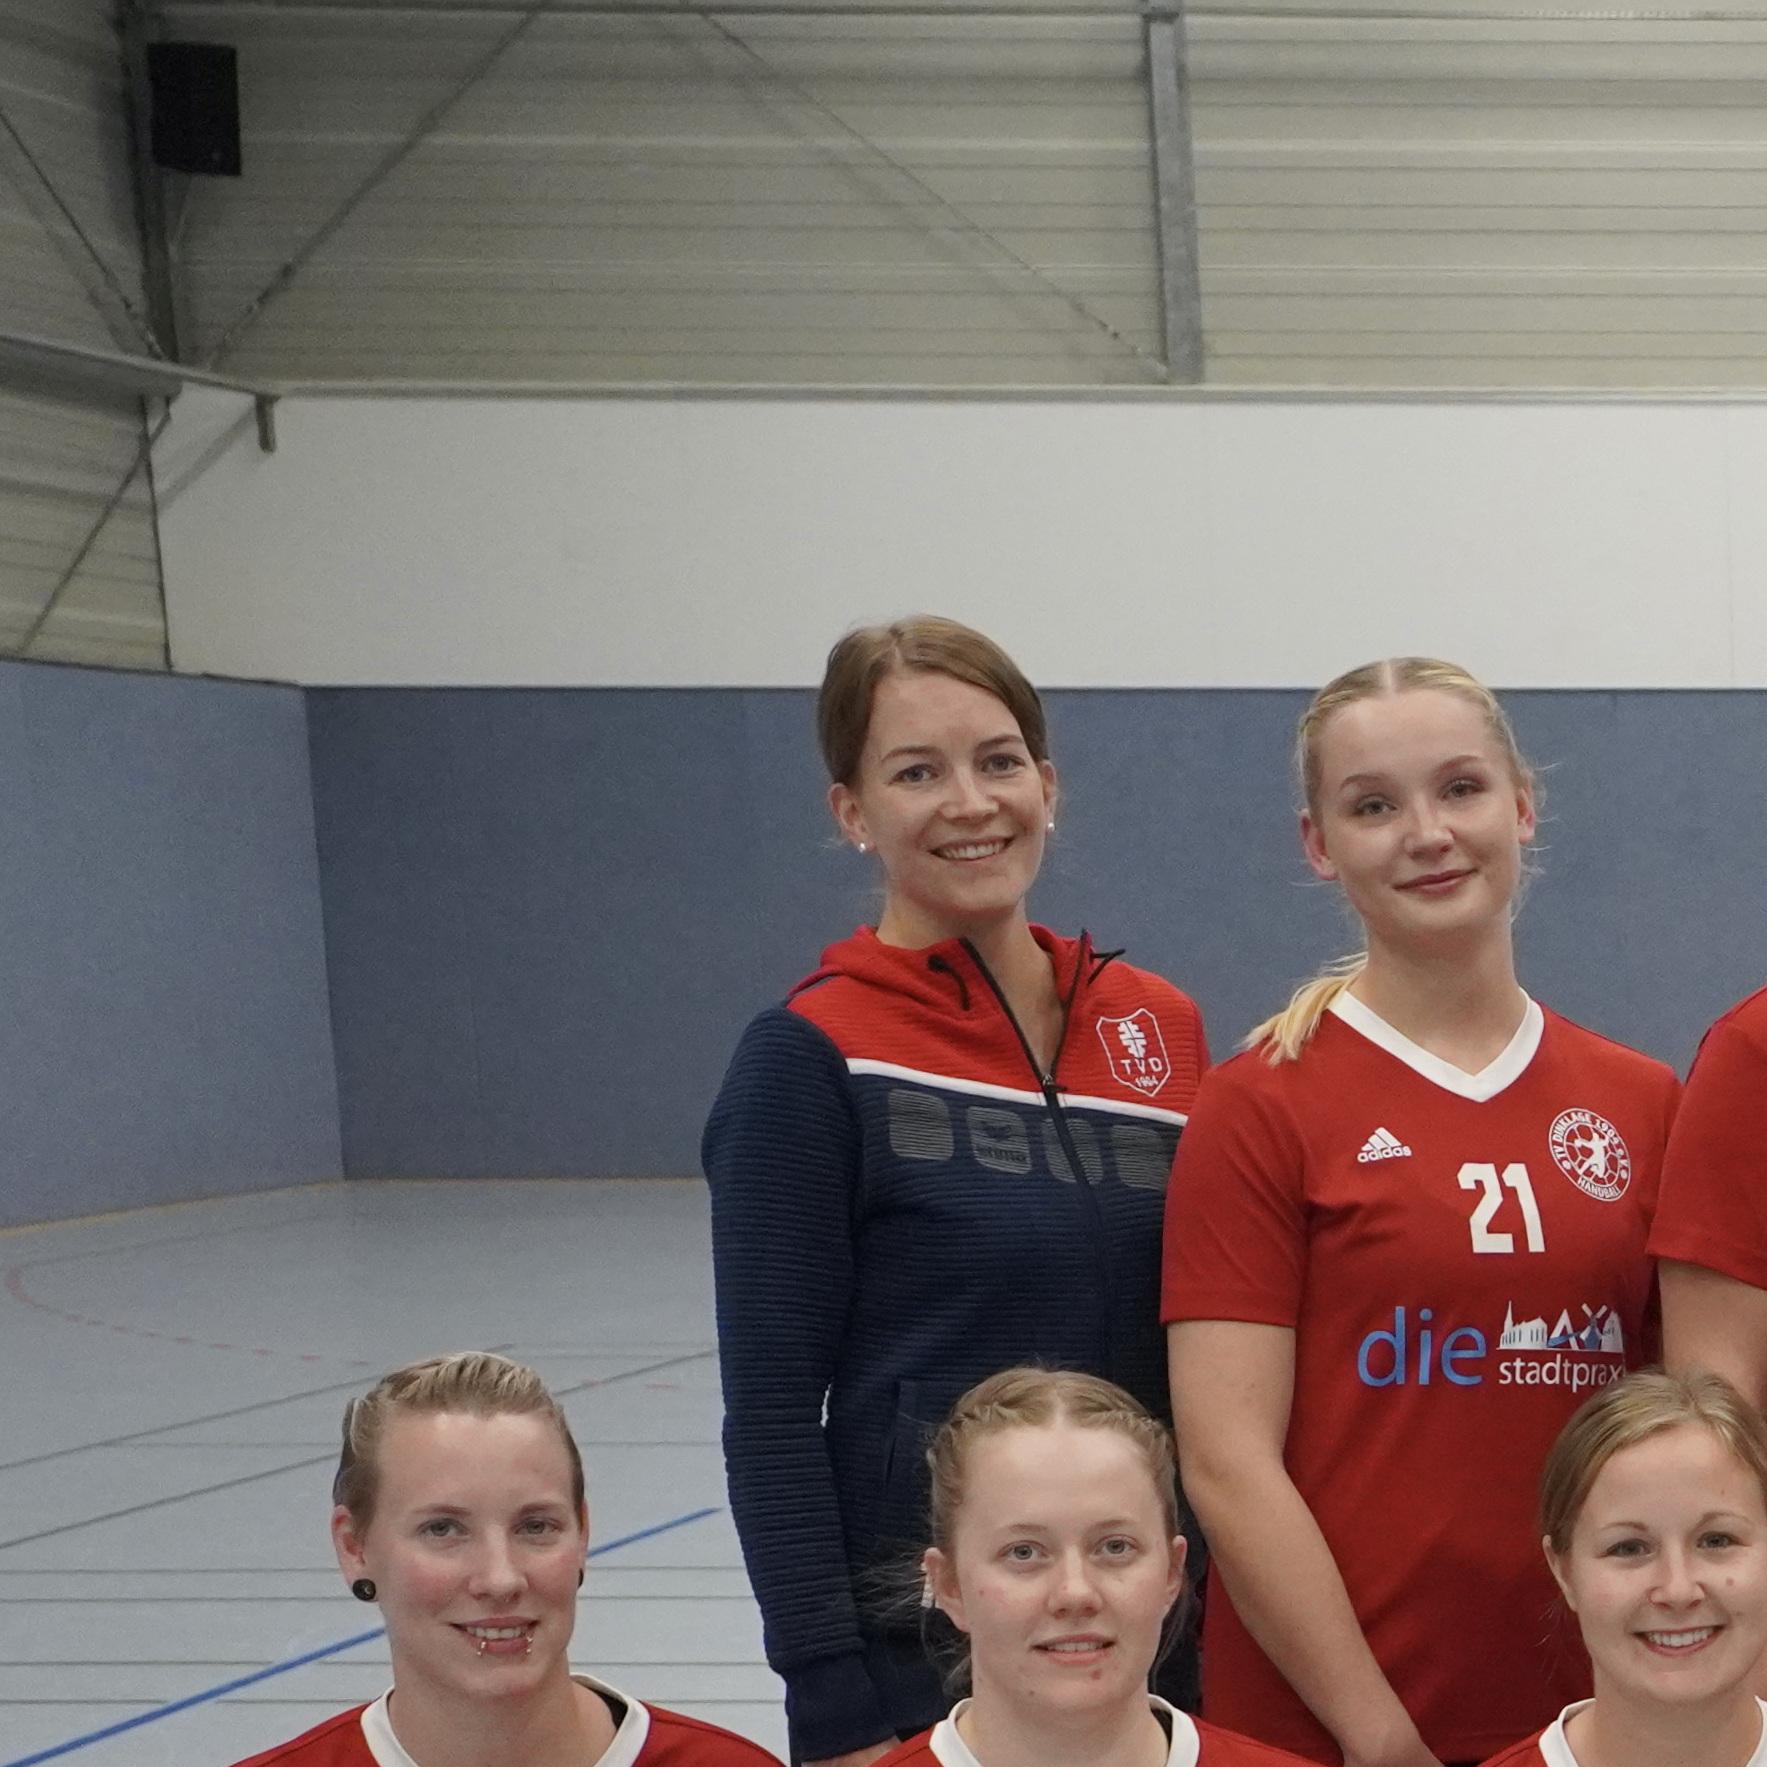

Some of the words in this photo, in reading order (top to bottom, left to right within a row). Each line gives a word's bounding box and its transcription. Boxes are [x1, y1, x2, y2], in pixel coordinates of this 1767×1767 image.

[1357, 1145, 1412, 1163] adidas
[1553, 1145, 1564, 1158] TV
[1458, 1163, 1544, 1253] 21
[1358, 1306, 1486, 1386] die
[1499, 1353, 1624, 1393] stadtprax
